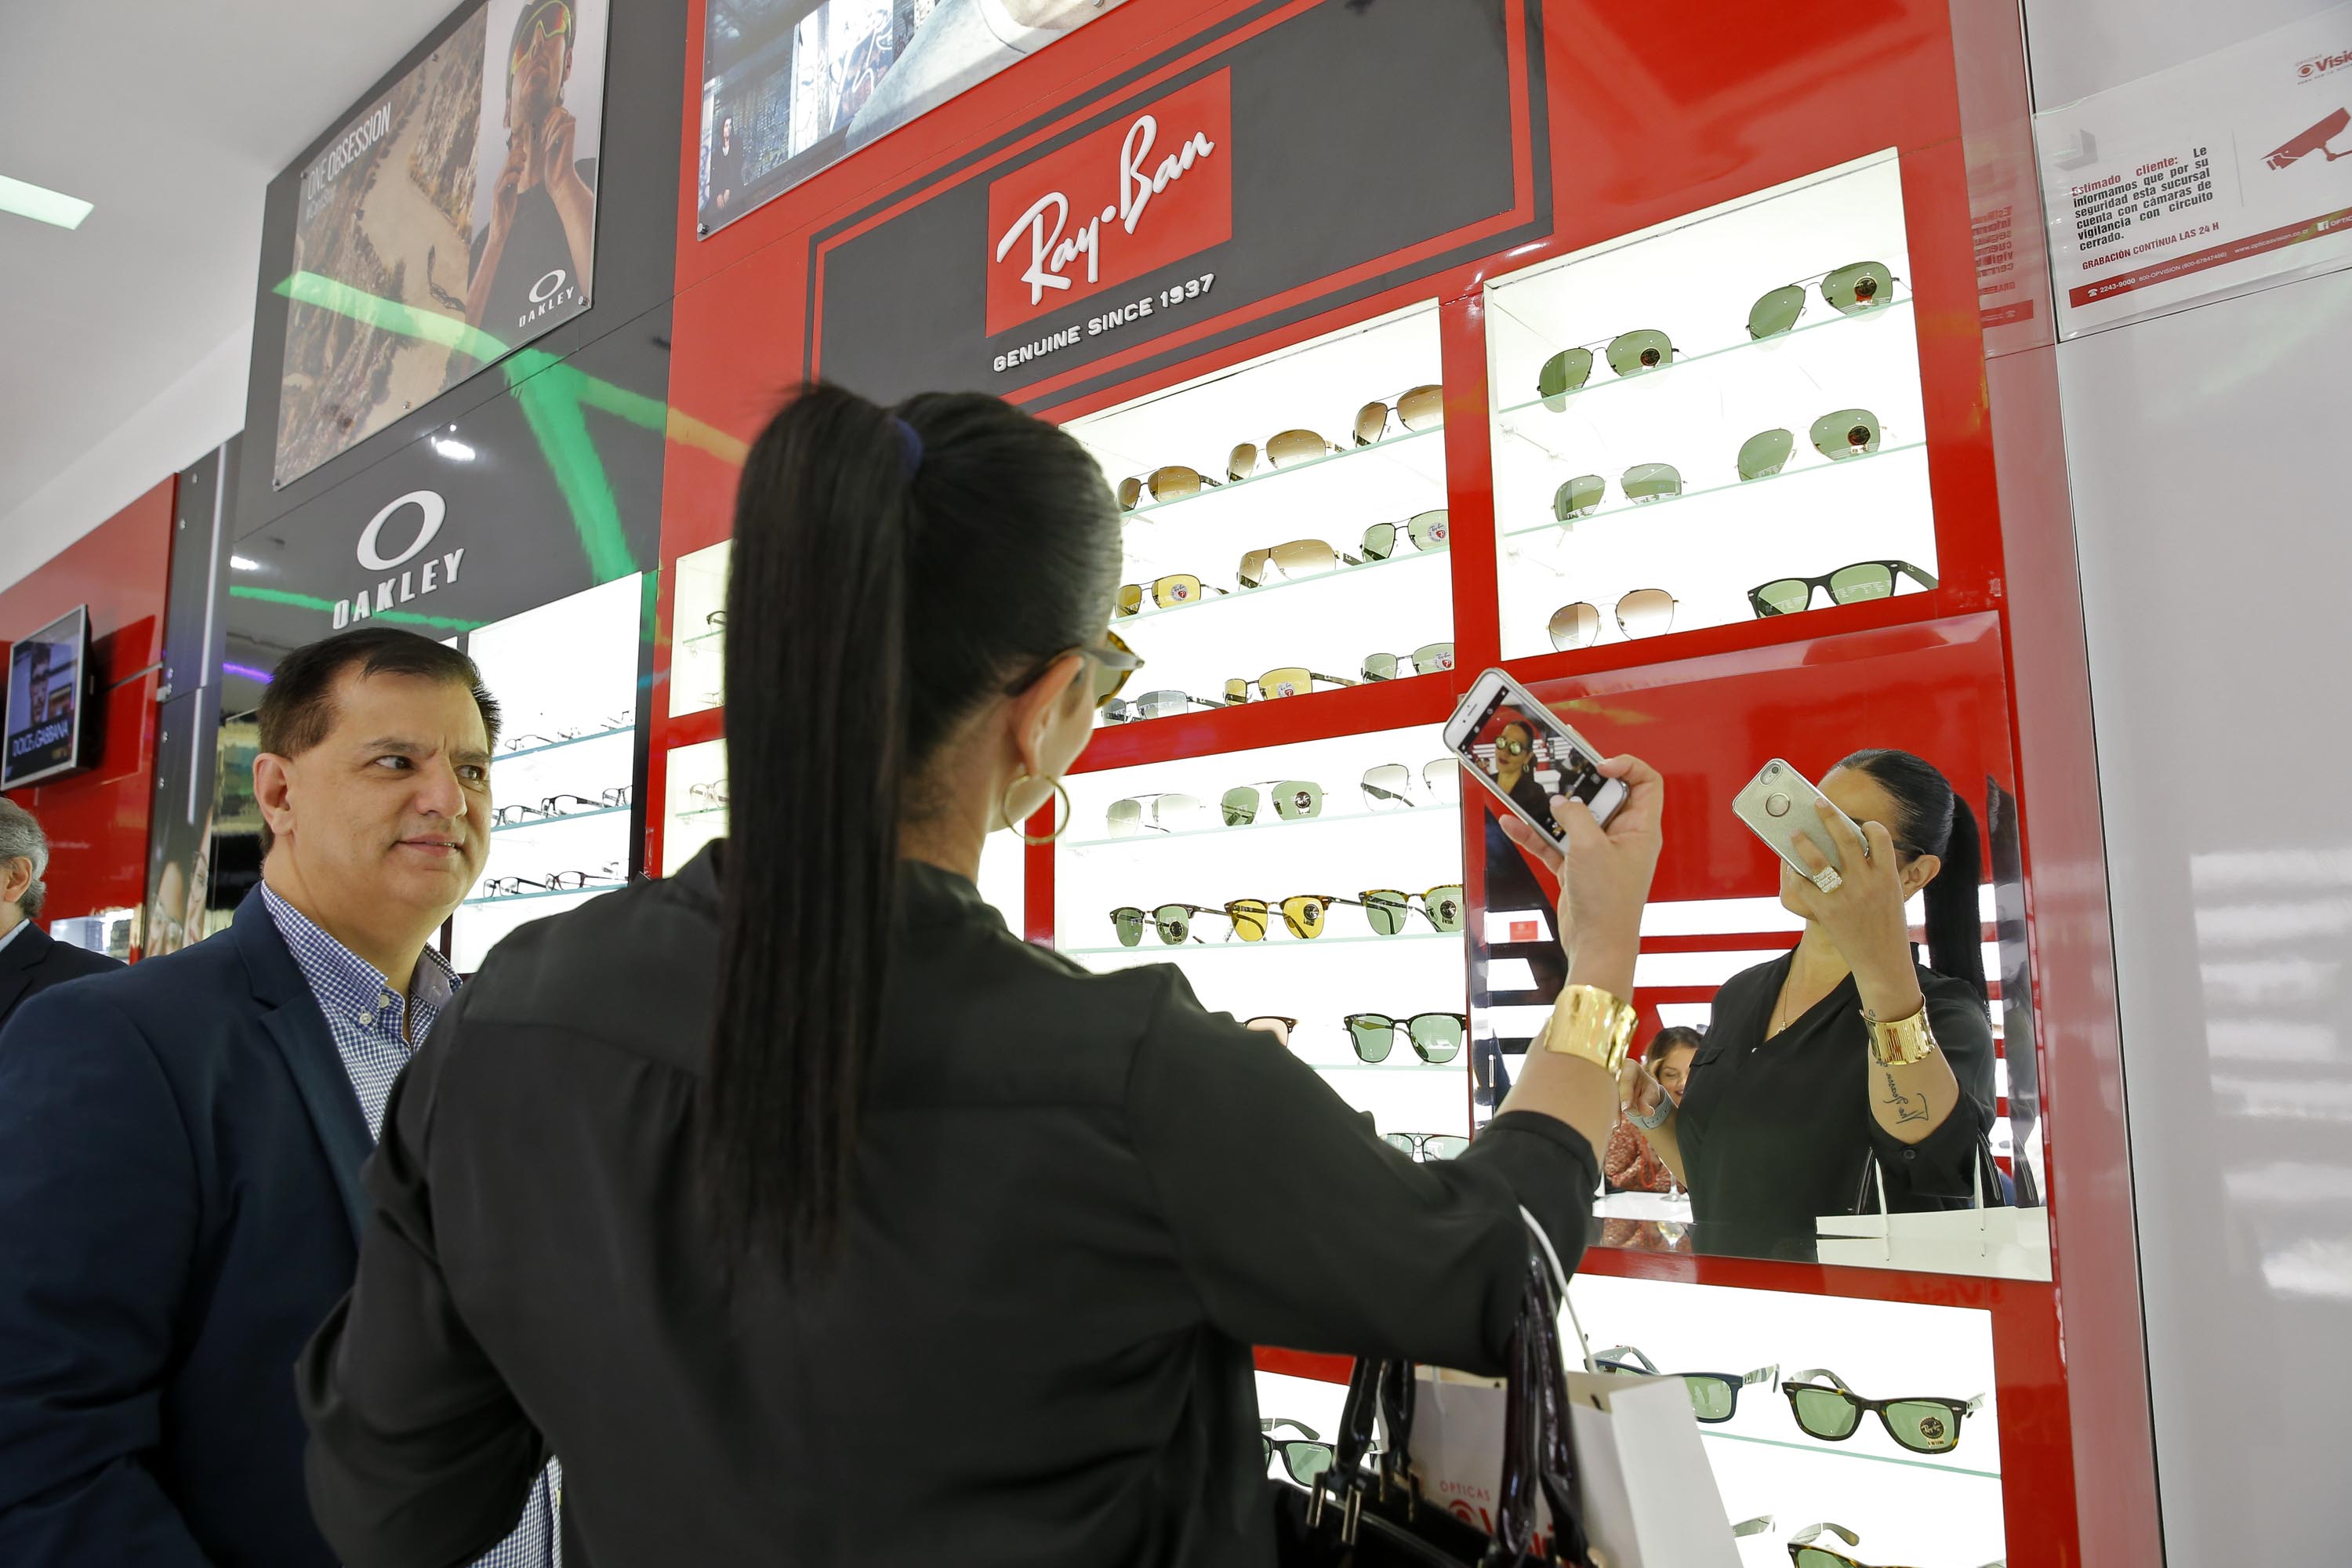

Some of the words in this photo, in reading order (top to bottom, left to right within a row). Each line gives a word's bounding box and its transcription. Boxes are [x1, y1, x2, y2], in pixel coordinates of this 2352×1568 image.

[307, 158, 327, 200] ONE
[328, 101, 391, 181] OBSESSION
[2071, 175, 2122, 197] Estimado
[2136, 156, 2178, 176] cliente:
[2193, 147, 2208, 158] Le
[2074, 180, 2138, 208] informamos
[2143, 172, 2164, 187] que
[2170, 164, 2189, 179] por
[2194, 158, 2209, 169] su
[2075, 194, 2129, 219] seguridad
[2132, 187, 2157, 201] esta
[2161, 168, 2210, 191] sucursal
[2077, 212, 2113, 229] cuenta
[2118, 204, 2138, 217] con
[2143, 187, 2192, 209] cámaras
[2198, 180, 2212, 192] de
[2078, 217, 2131, 241] vigilancia
[2140, 208, 2160, 221] con
[2169, 191, 2213, 212] circuito
[2080, 231, 2125, 251] cerrado.
[2082, 249, 2131, 270] GRABACIÓN
[2132, 237, 2177, 255] CONTÍNUA
[2180, 229, 2196, 241] LAS
[2198, 225, 2210, 234] 24
[2212, 222, 2220, 230] H
[518, 285, 574, 328] OAKLEY
[2100, 278, 2136, 293] 2243-9000
[993, 325, 1082, 372] GENUINE
[1088, 297, 1154, 337] SINCE
[1160, 273, 1216, 308] 1937
[332, 548, 465, 630] OAKLEY
[1439, 1479, 1490, 1501] OPTICAS
